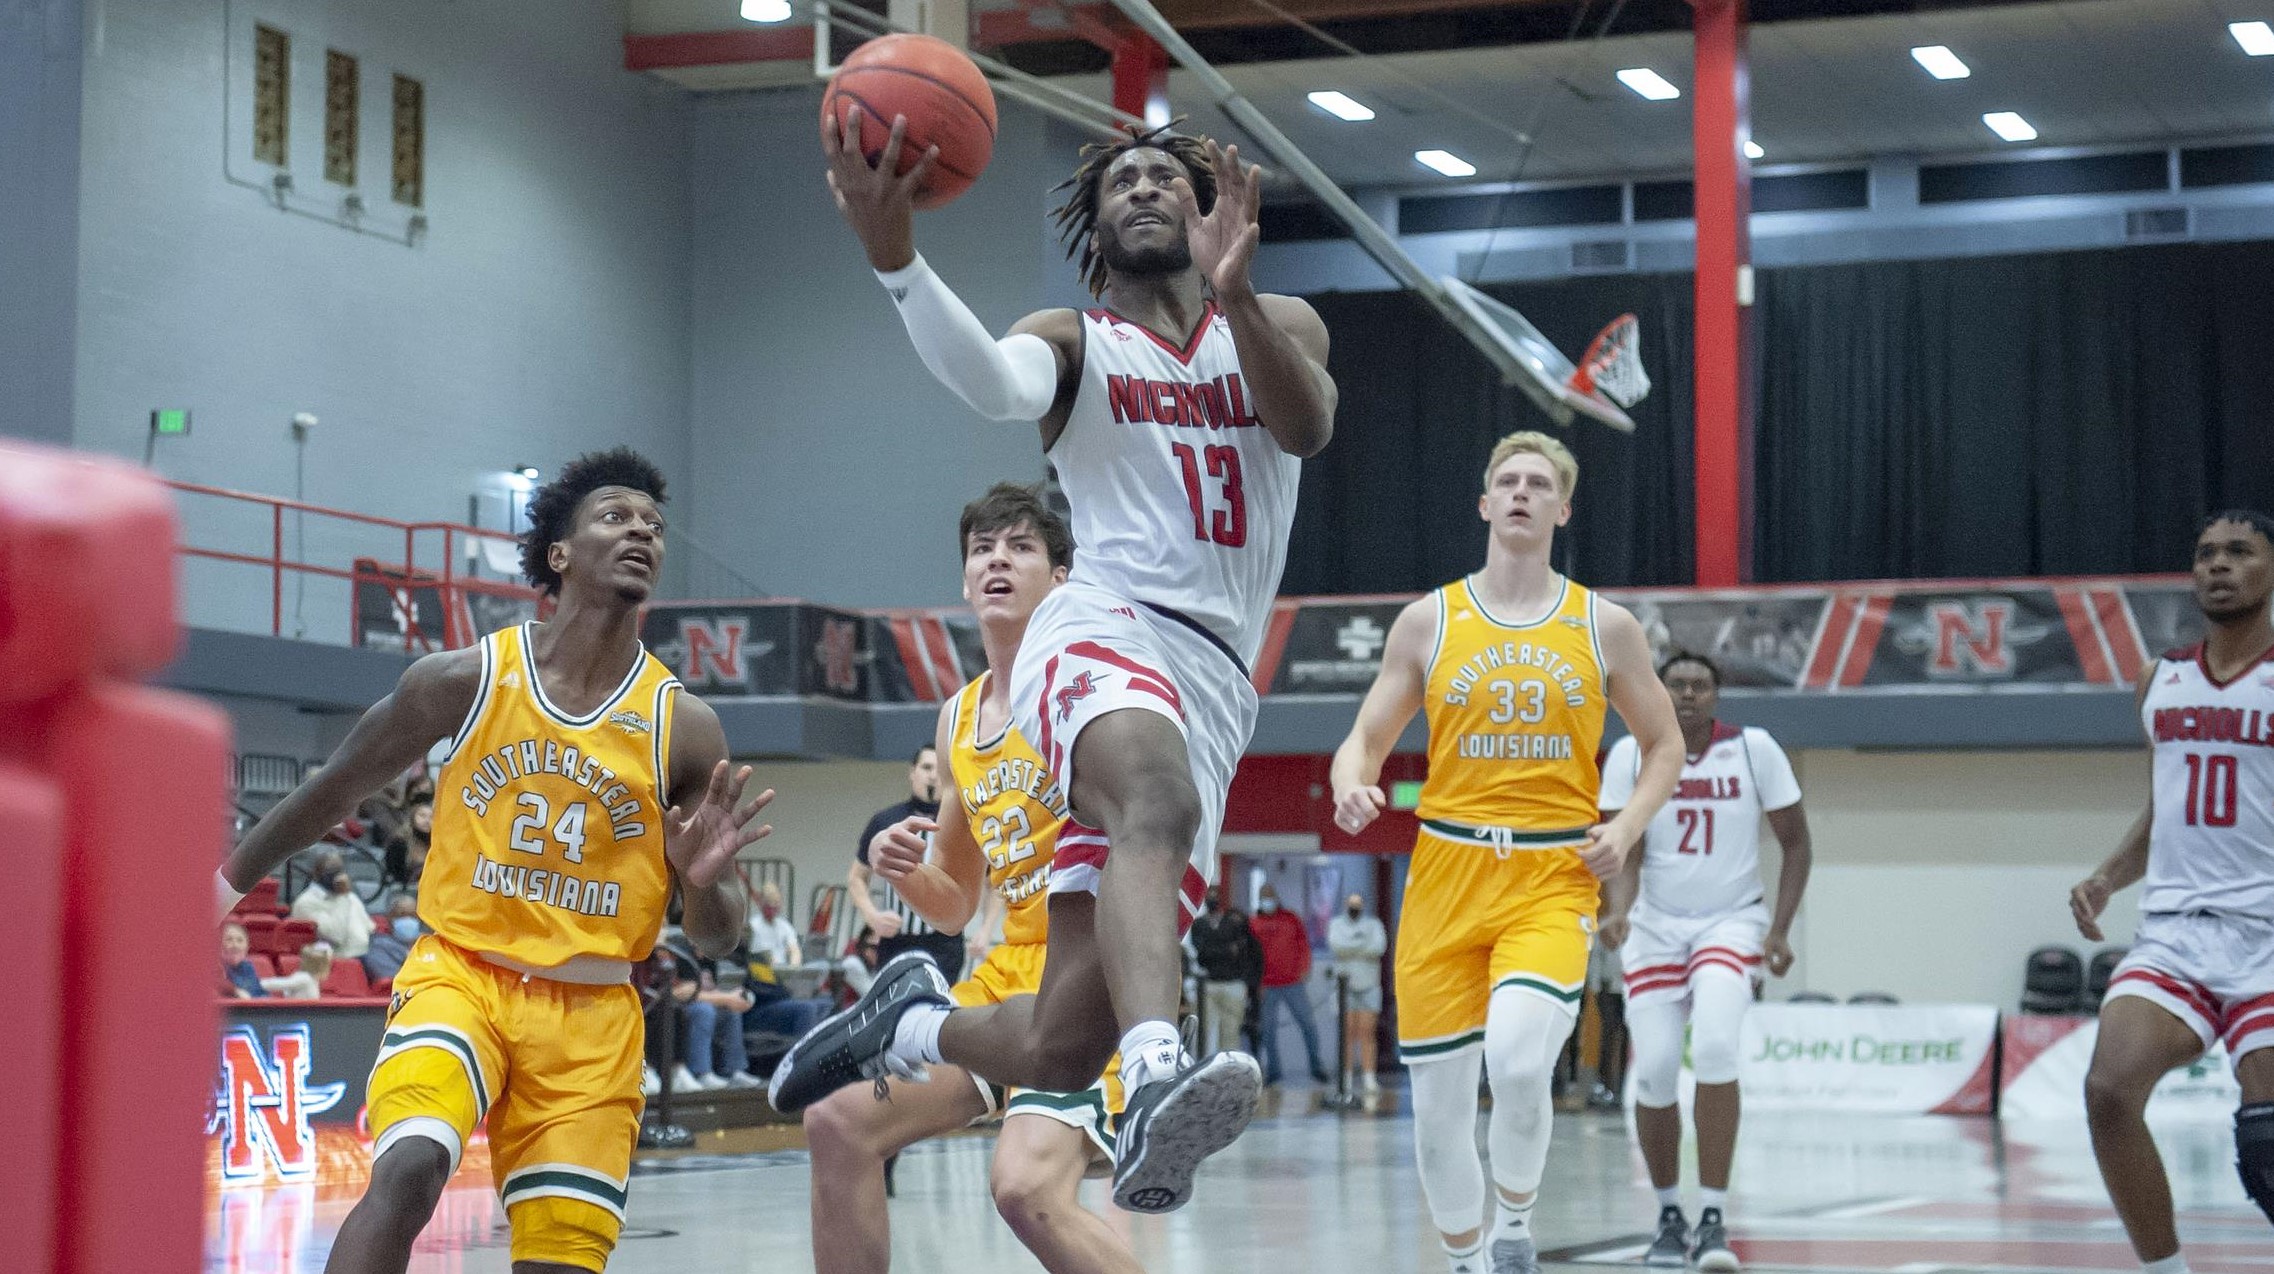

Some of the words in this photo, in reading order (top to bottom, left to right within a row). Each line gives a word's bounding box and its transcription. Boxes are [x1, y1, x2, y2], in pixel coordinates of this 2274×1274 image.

[1107, 373, 1265, 431] NICHOLL
[1172, 441, 1248, 549] 13
[1445, 641, 1586, 708] SOUTHEASTERN
[1488, 679, 1546, 724] 33
[1458, 733, 1572, 760] LOUISIANA
[462, 738, 646, 843] SOUTHEASTERN
[2185, 753, 2238, 828] 10
[509, 792, 588, 864] 24
[981, 804, 1038, 870] 22
[1677, 808, 1715, 855] 21
[471, 853, 621, 917] LOUISIANA
[1752, 1034, 1844, 1063] JOHN
[1850, 1034, 1965, 1065] DEERE
[222, 1028, 315, 1182] N
